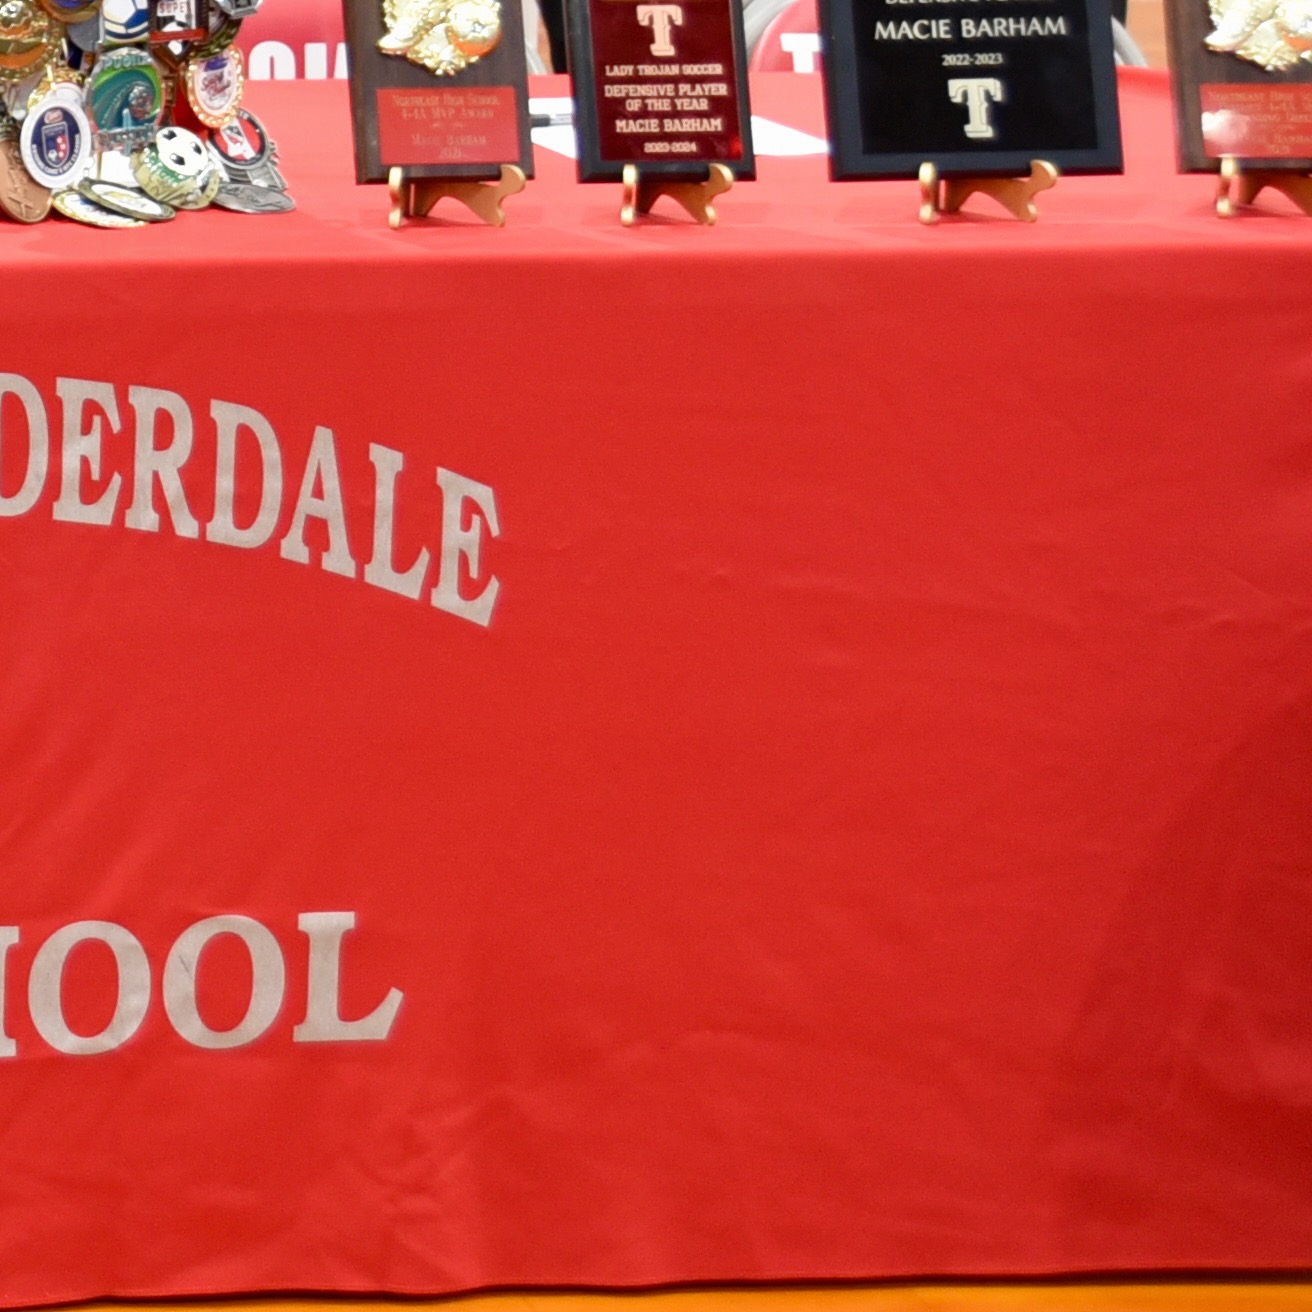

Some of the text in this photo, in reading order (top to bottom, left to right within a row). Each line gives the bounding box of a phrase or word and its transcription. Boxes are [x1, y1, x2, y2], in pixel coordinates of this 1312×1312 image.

[636, 5, 682, 56] T
[874, 16, 1067, 40] MACIE BARHAM
[941, 53, 1003, 66] 2022-2023
[605, 63, 723, 77] LADY TROJAN SOCCER
[604, 83, 728, 98] DEFENSIVE PLAYER
[626, 98, 708, 112] OF THE YEAR
[948, 78, 1004, 138] T
[615, 118, 722, 133] MACIE BARHAM
[644, 141, 697, 154] 2023-2024
